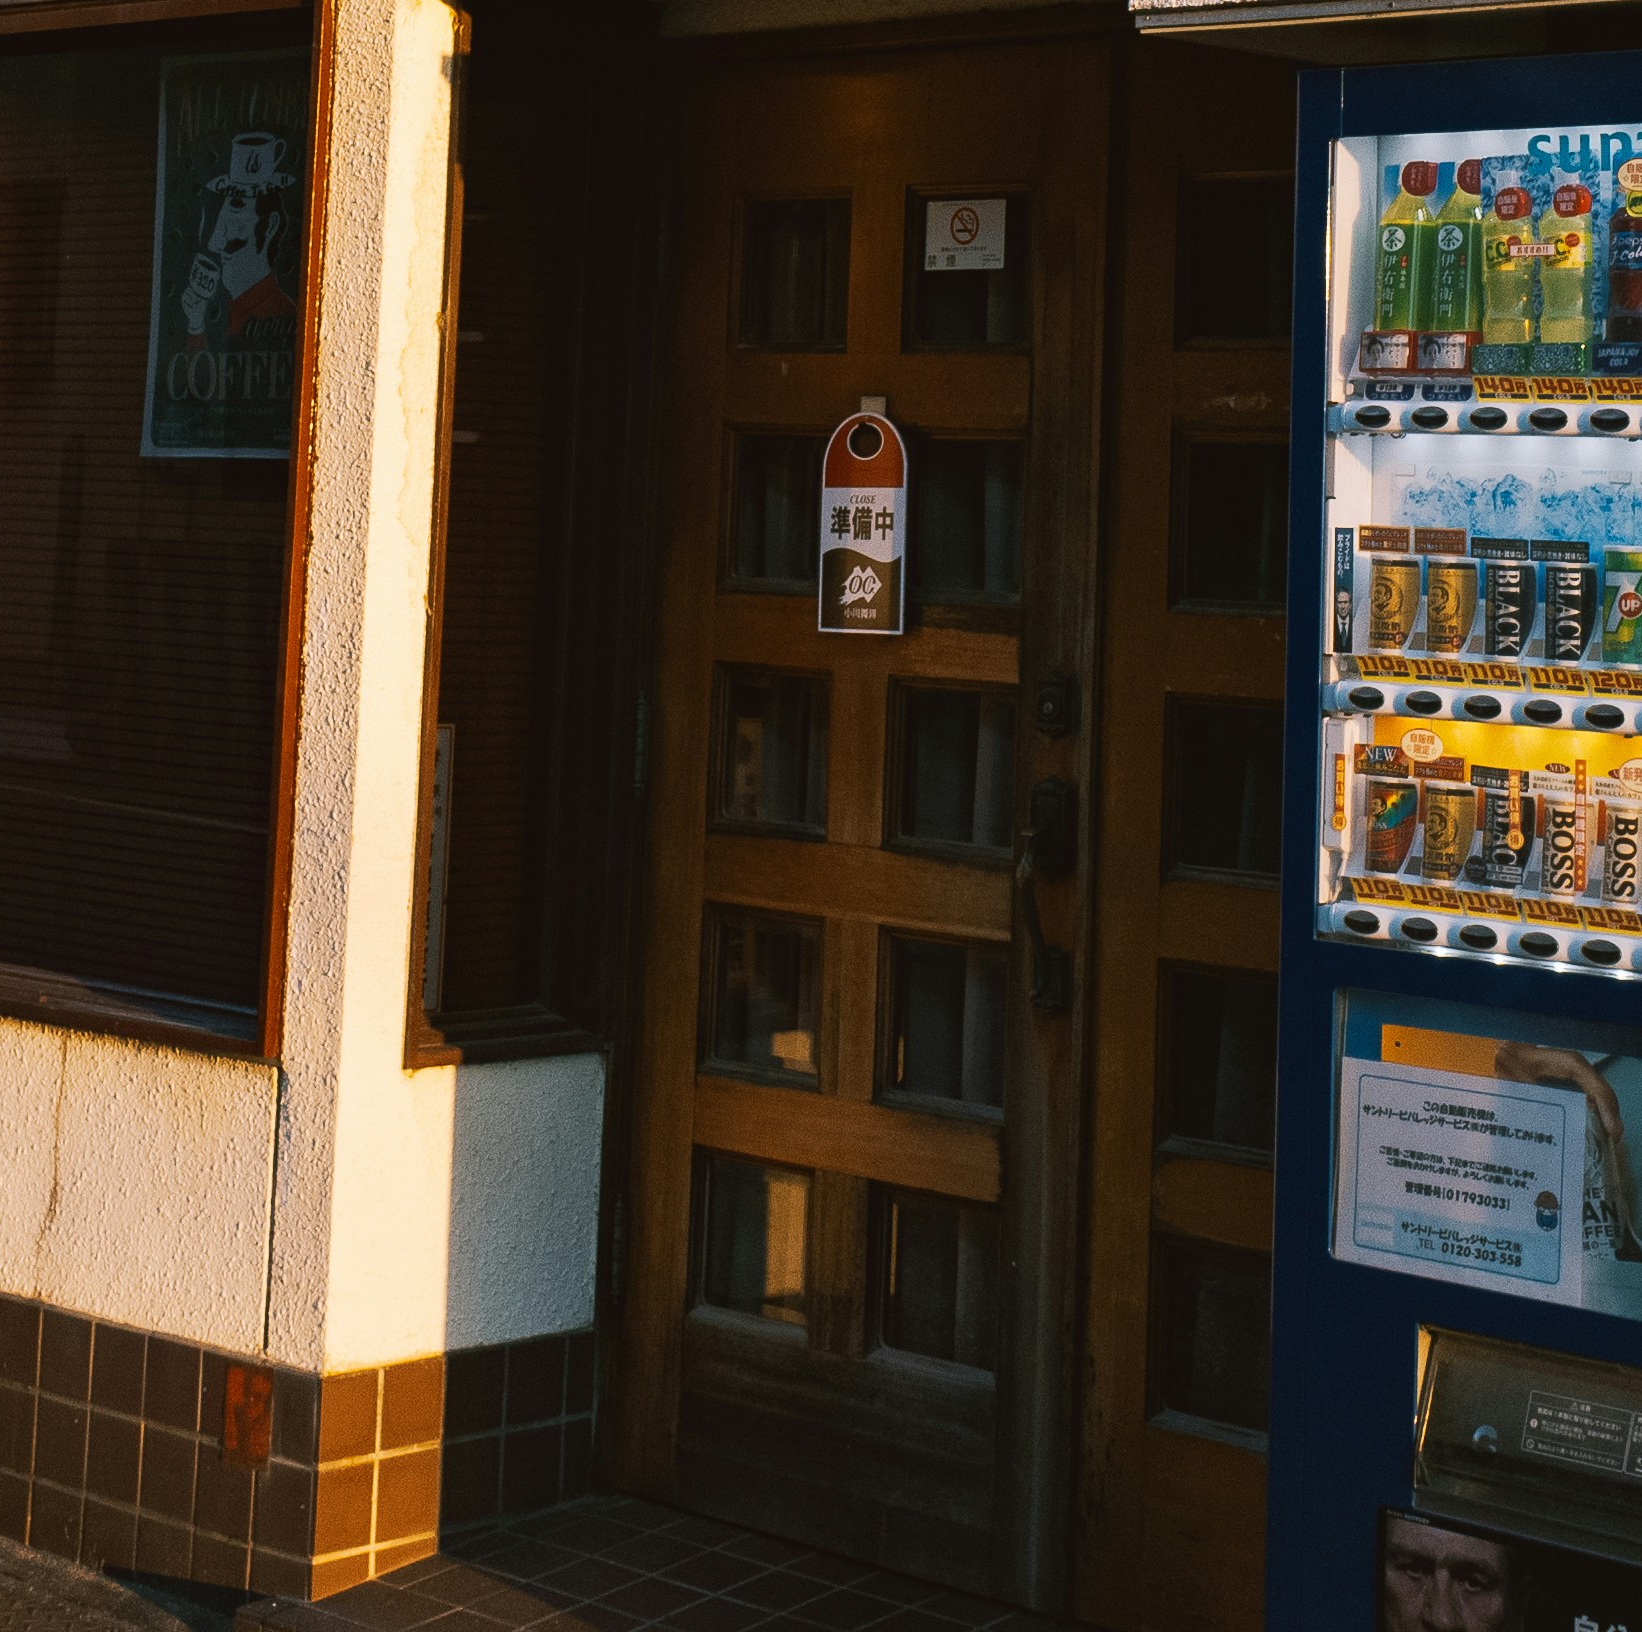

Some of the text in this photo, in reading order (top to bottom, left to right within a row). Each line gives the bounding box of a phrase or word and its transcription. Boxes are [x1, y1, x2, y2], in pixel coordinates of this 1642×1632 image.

[1384, 229, 1403, 249] 茶
[1440, 227, 1460, 249] 茶
[166, 351, 294, 402] COFFE
[1475, 377, 1526, 392] 140円
[1532, 377, 1586, 393] 140円
[850, 494, 876, 504] CLOSE
[830, 506, 894, 540] 準備中
[1494, 566, 1521, 652] BLACK
[1555, 569, 1582, 655] BLACK
[1359, 656, 1409, 671] 110円
[1412, 660, 1464, 675] 110円
[1468, 664, 1521, 679] 110円
[1530, 668, 1582, 684] 110円
[1365, 746, 1397, 761] NEW
[1550, 808, 1576, 889] BOSS
[1611, 816, 1638, 898] BOSS
[1353, 878, 1404, 896] 110円
[1407, 885, 1458, 903] 110円
[1463, 891, 1517, 911] 110円
[1522, 900, 1577, 919] 110円
[1583, 907, 1639, 926] 110円
[1418, 1238, 1522, 1267] TEL 0120-303-558
